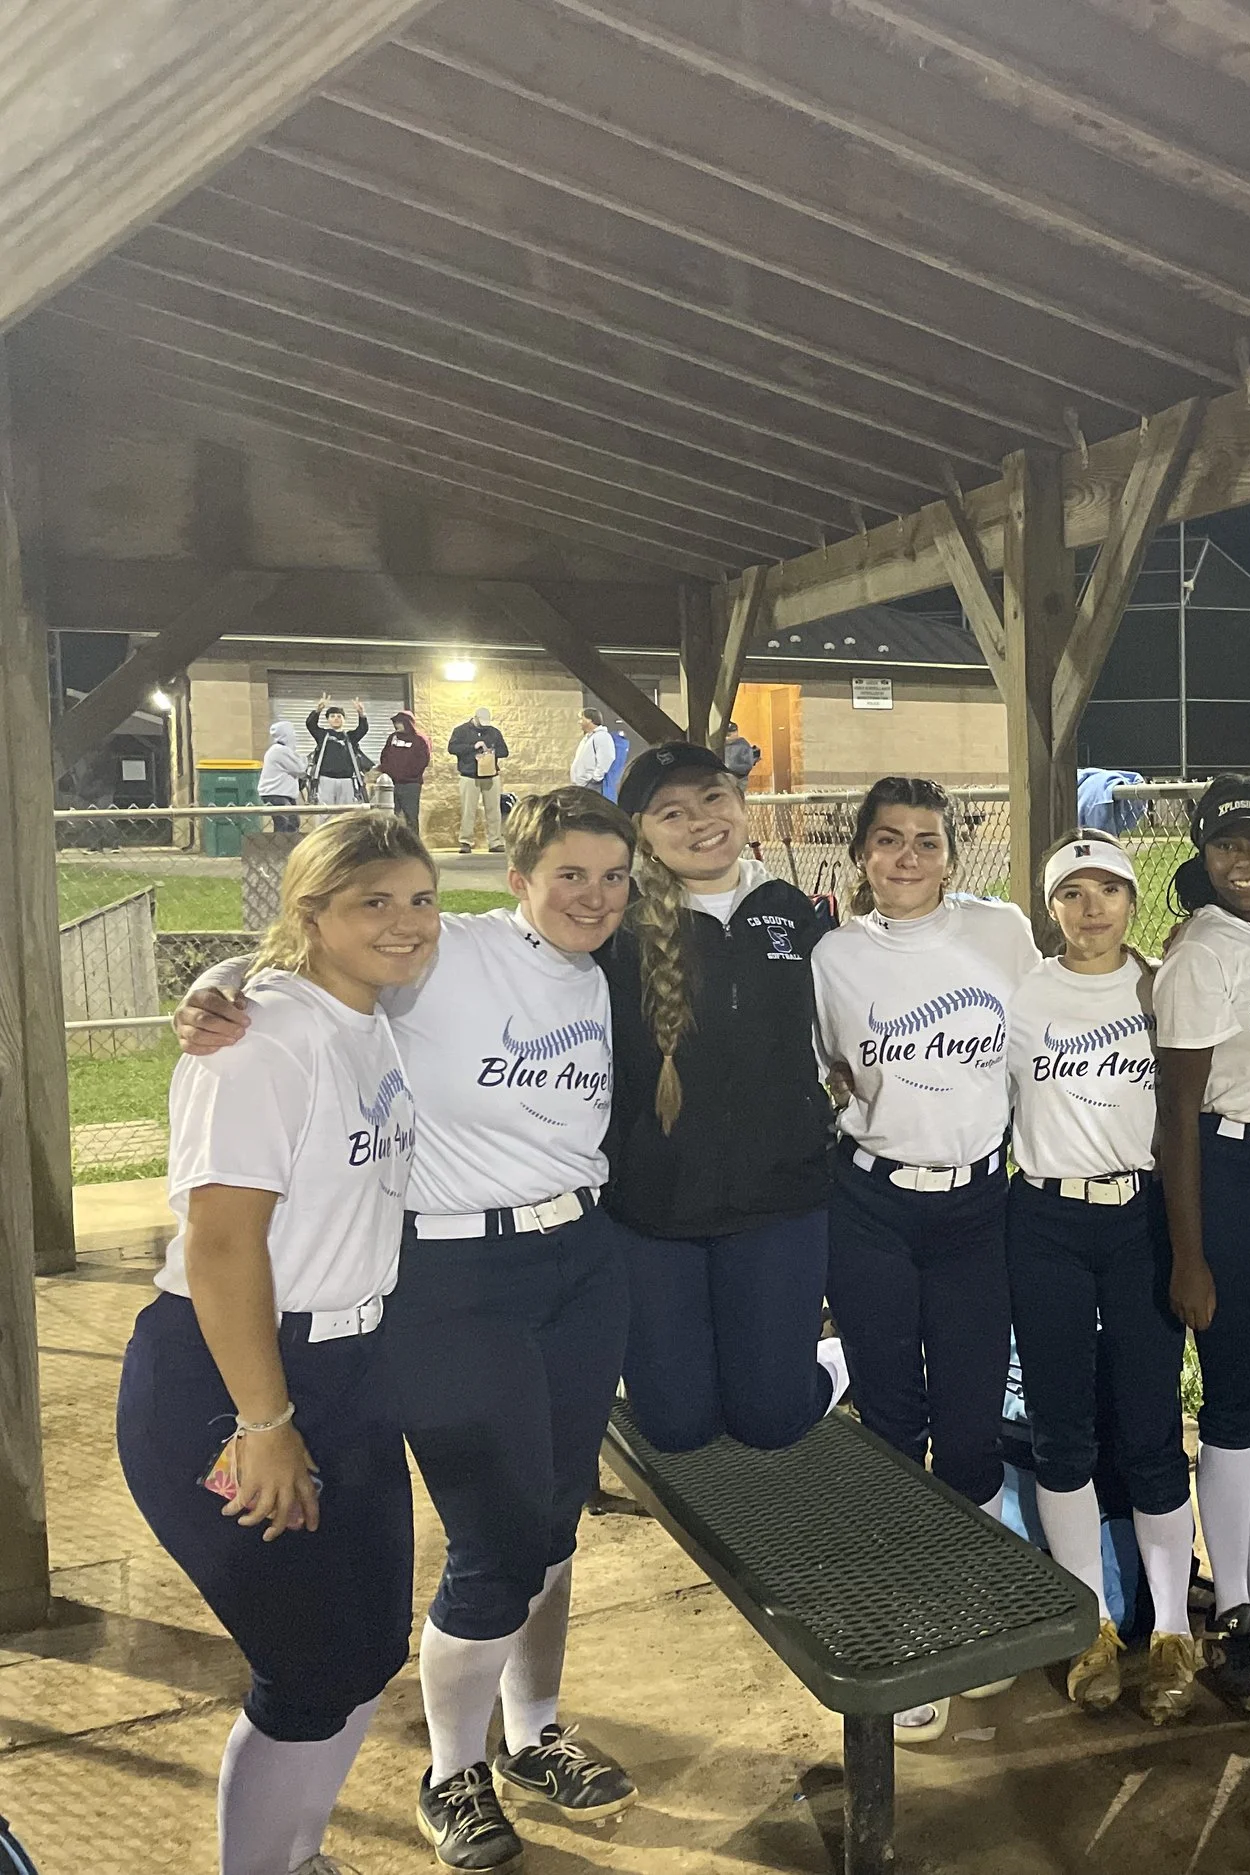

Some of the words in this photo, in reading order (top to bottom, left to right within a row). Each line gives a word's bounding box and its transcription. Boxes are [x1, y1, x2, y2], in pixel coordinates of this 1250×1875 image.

[1073, 844, 1091, 858] N
[747, 917, 762, 927] CB
[762, 915, 796, 929] SOUTH
[767, 952, 803, 960] SOFTBALL
[859, 1034, 916, 1067] Blue
[924, 1023, 1006, 1064] Angels
[477, 1056, 549, 1088] Blue
[555, 1061, 614, 1101] Angel
[1032, 1051, 1089, 1081] Blue
[1097, 1051, 1159, 1083] Ange
[348, 1125, 391, 1166] Blue
[394, 1122, 415, 1162] Ang
